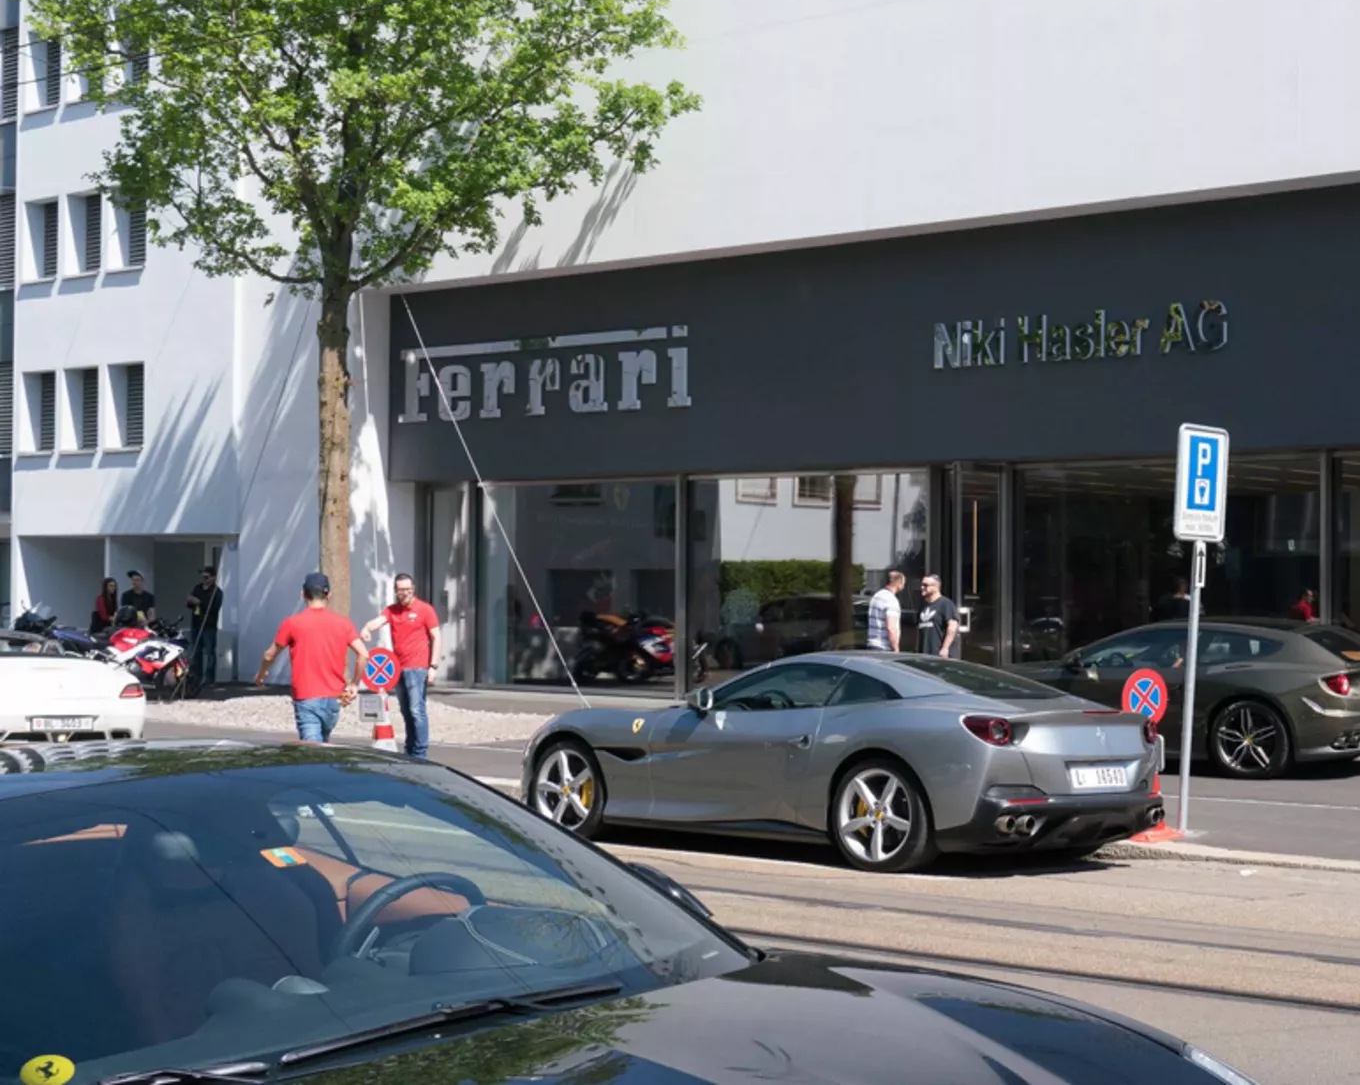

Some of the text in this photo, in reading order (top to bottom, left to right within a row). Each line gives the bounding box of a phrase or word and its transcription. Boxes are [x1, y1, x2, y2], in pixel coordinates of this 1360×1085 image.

[933, 300, 1229, 369] Niki Hasler AG
[398, 325, 693, 423] Ferrari
[1197, 442, 1212, 477] P
